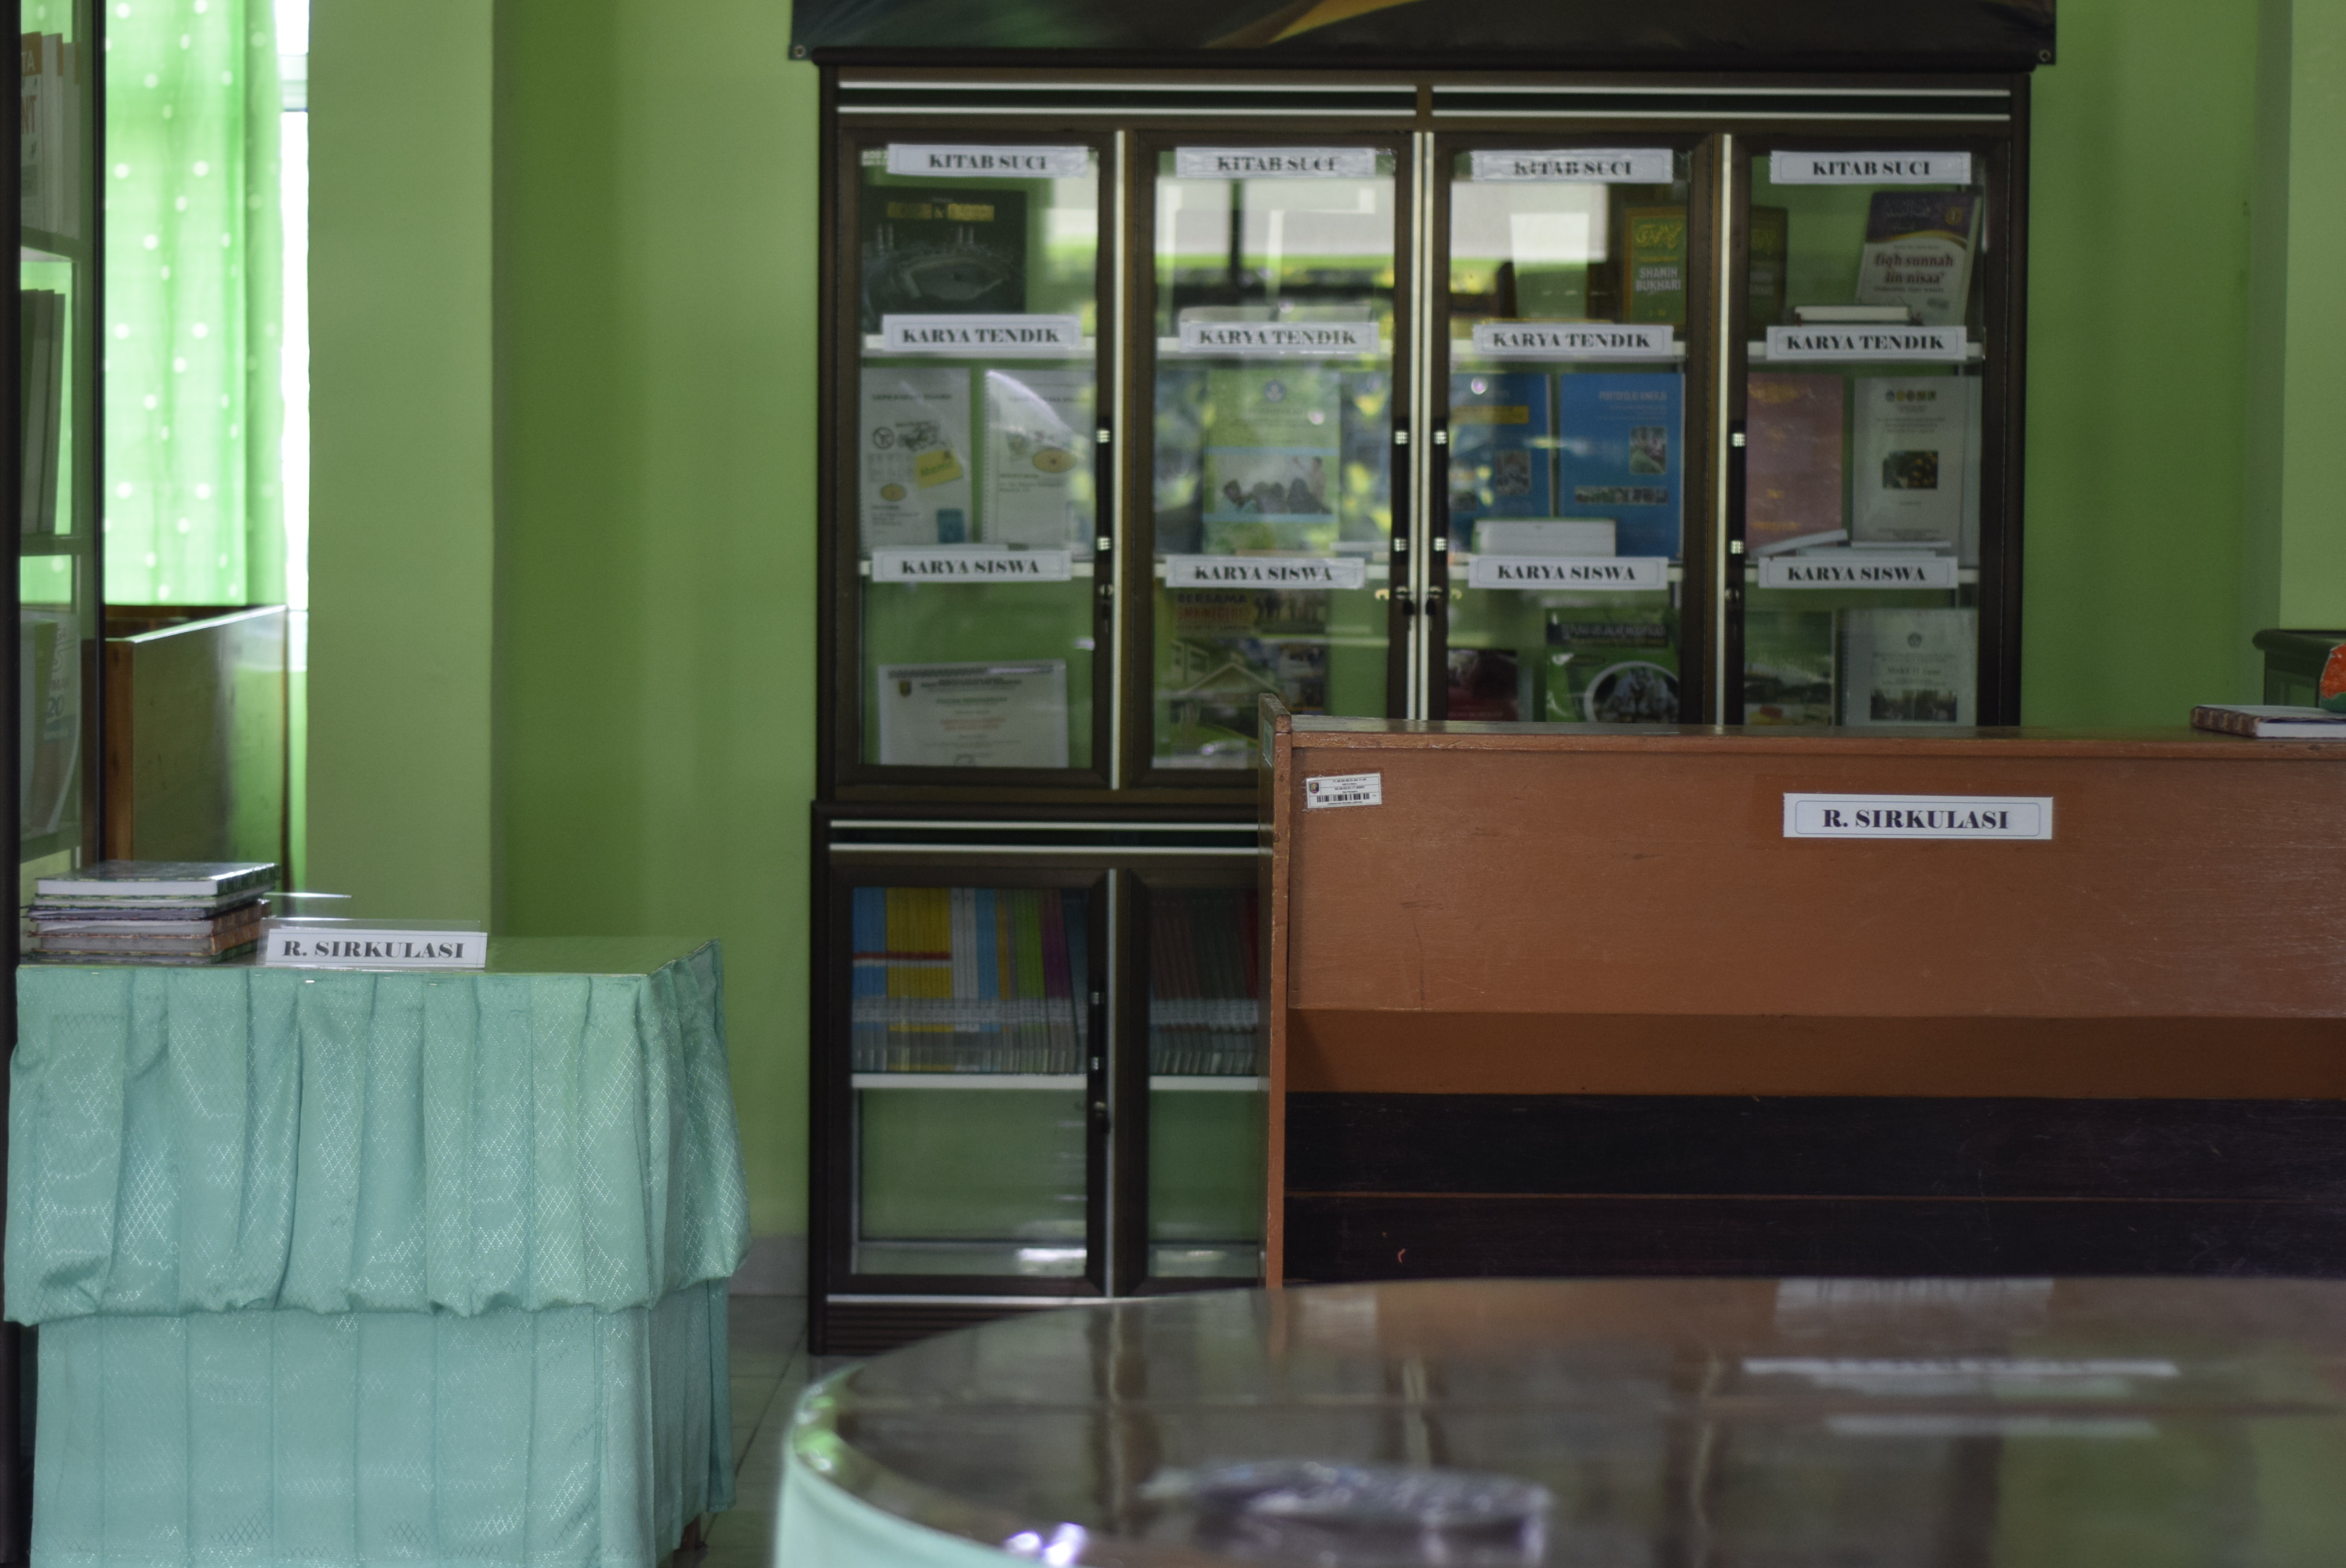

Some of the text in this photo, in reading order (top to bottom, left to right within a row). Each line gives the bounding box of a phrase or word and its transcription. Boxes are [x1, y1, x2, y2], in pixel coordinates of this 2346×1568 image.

[928, 154, 1047, 169] KITAB SUCI
[1217, 156, 1335, 171] KITAB SUCI
[1514, 160, 1632, 176] KITAB SUCI
[1813, 160, 1930, 176] KITAB SUCI
[902, 328, 1059, 343] KARYA TENDIK
[1199, 329, 1357, 345] KARYA TENDIK
[1492, 332, 1651, 348] KARYA TENDIK
[1786, 334, 1945, 350] KARYA TENDIK
[901, 559, 1040, 575] KARYA SISWA
[1194, 565, 1334, 581] KARYA SISWA
[1498, 564, 1636, 580] KARYA SISWA
[1788, 566, 1926, 582] KARYA SISWA
[1823, 809, 2009, 829] R. SIRKULASI
[283, 940, 464, 960] R. SIRKULASI
